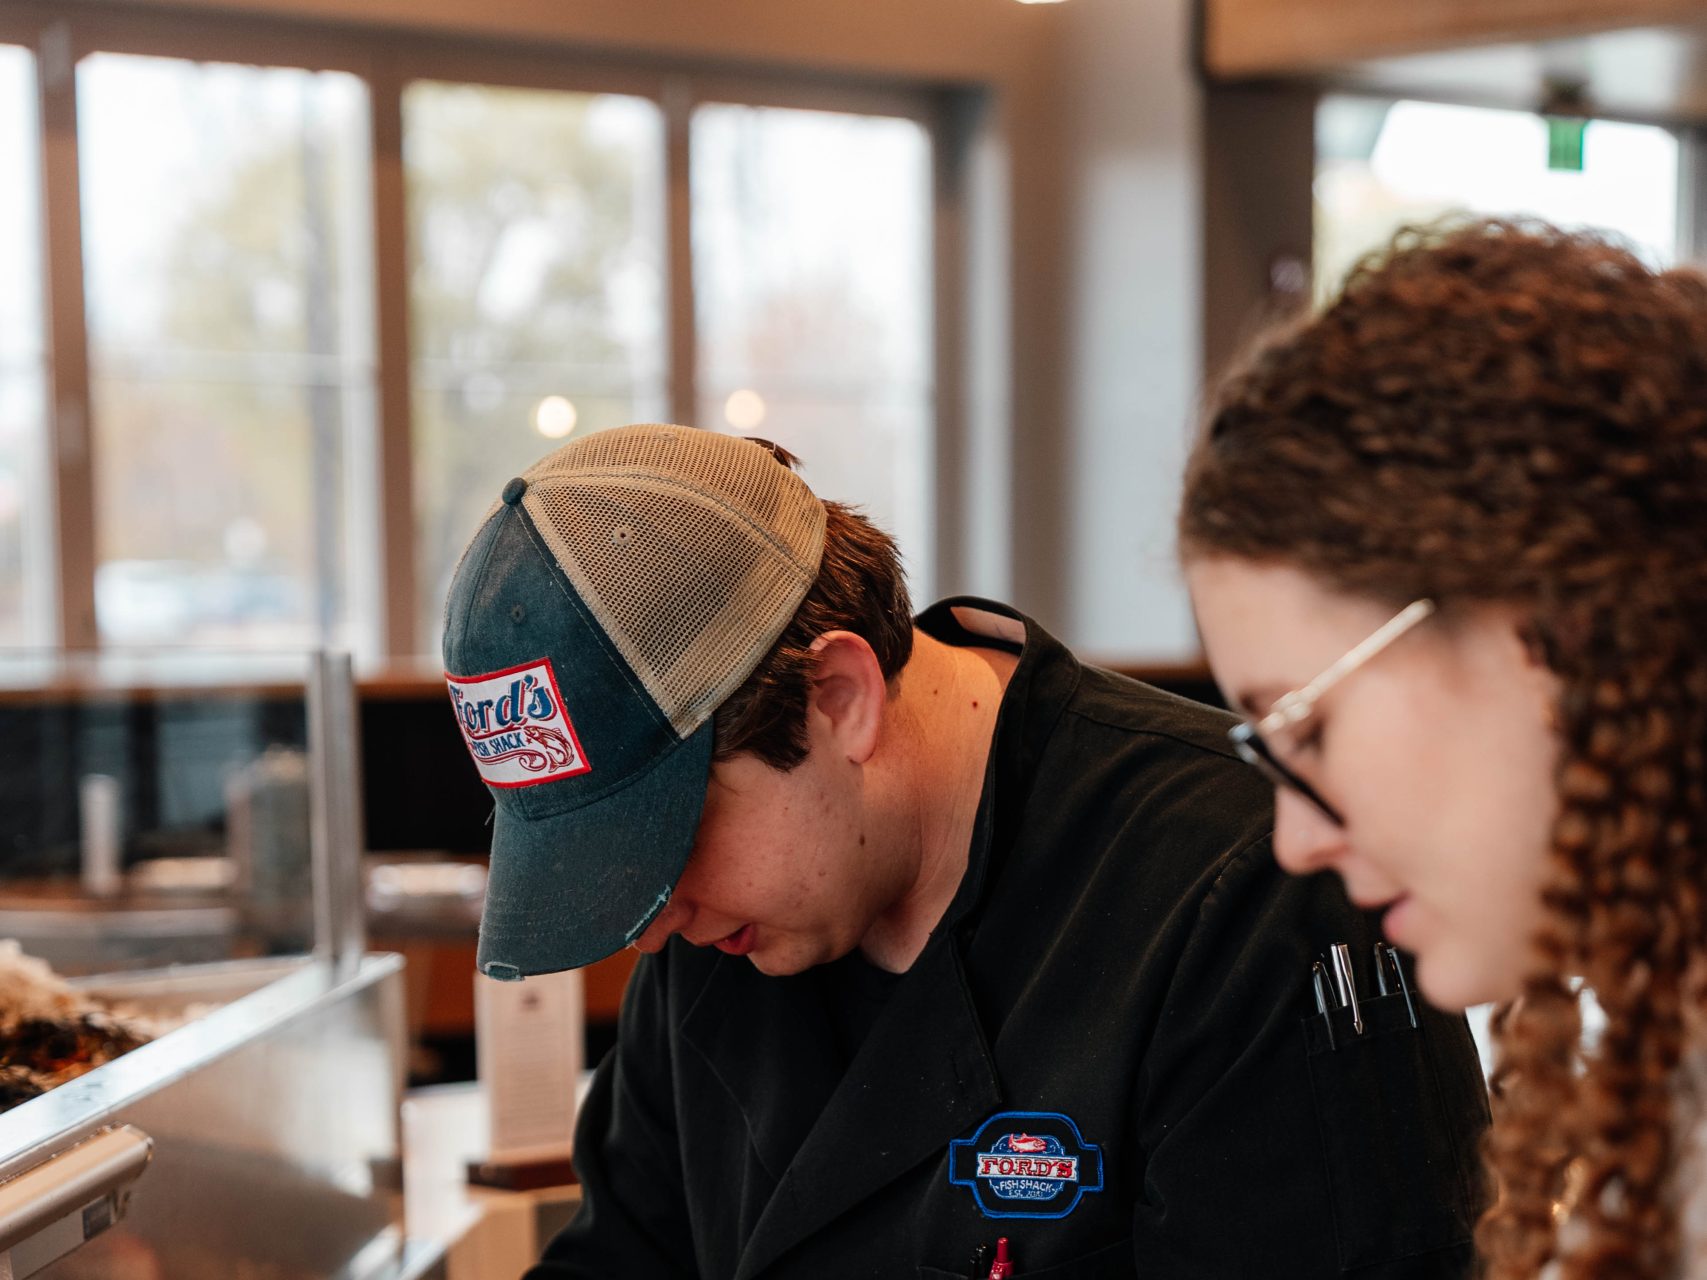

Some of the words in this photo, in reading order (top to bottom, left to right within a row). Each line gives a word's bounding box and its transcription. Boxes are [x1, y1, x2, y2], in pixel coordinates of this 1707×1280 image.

[489, 732, 525, 755] SHACK
[981, 1158, 1073, 1178] FORD'S
[1000, 1179, 1019, 1191] FISH
[1020, 1179, 1053, 1193] SHACK
